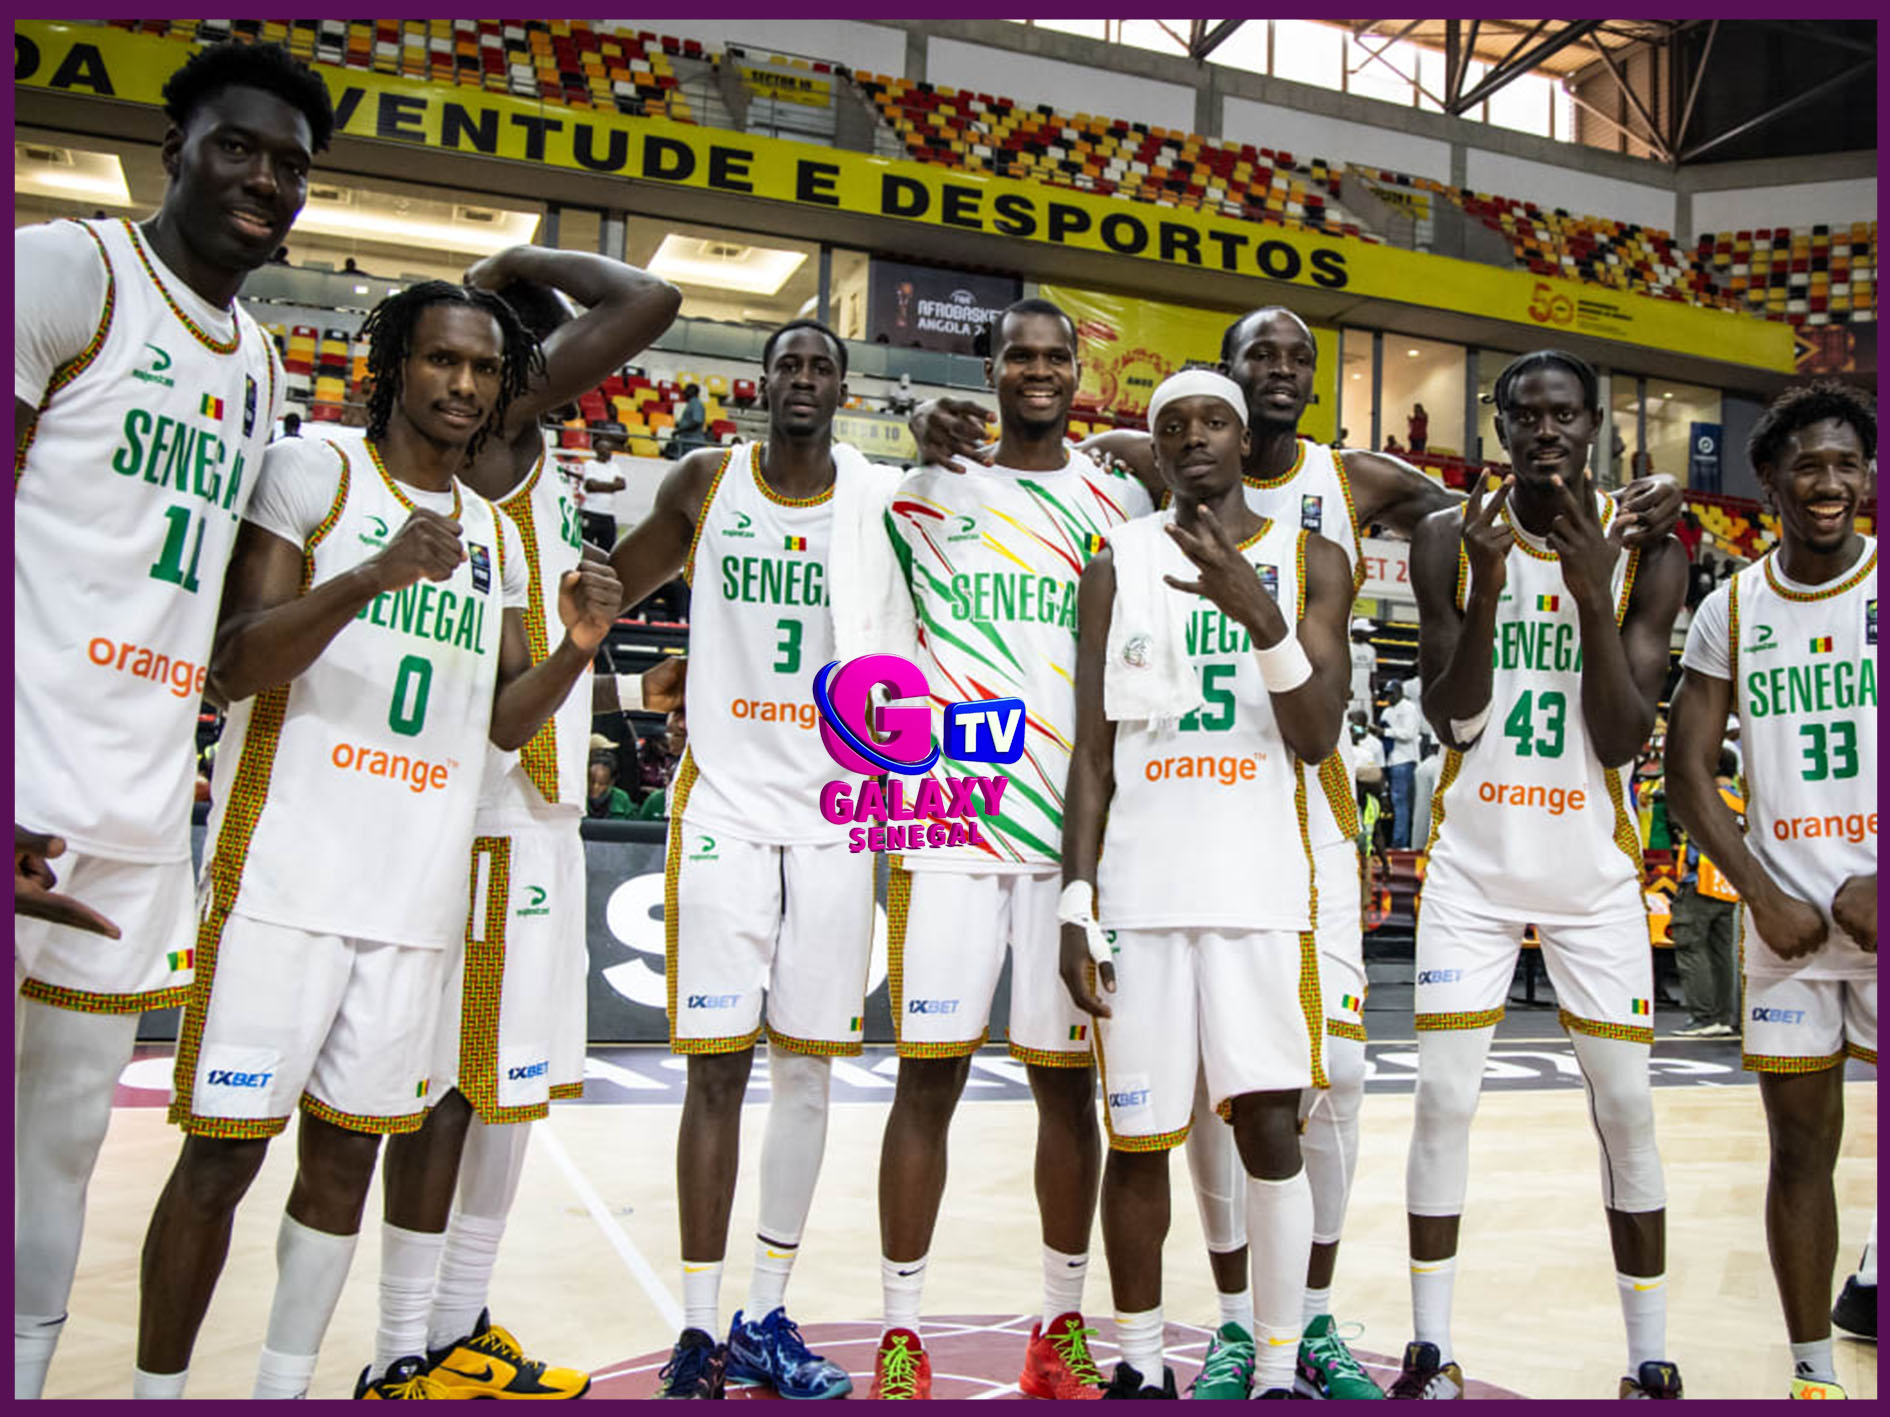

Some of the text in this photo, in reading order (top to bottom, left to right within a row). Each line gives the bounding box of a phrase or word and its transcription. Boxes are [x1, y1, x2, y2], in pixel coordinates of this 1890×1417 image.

[334, 86, 754, 194] VENTUDE
[796, 158, 840, 207] E
[881, 173, 1349, 289] DESPORTOS
[917, 317, 971, 336] ANGOLA
[112, 407, 244, 522] SENEGA
[722, 555, 830, 608] SENEG
[1366, 557, 1408, 582] ET 2
[356, 580, 486, 655] ENEGAL
[773, 618, 803, 675] 3
[388, 654, 433, 737] 0
[731, 698, 822, 730] orang
[1504, 689, 1567, 759] 43
[332, 742, 449, 794] orange
[1145, 755, 1258, 786] orange
[1799, 720, 1859, 782] 33
[1479, 781, 1586, 816] orange
[688, 995, 742, 1009] 1XBET
[909, 999, 960, 1014] 1XBET
[1752, 1007, 1806, 1025] 1XBET
[207, 1069, 273, 1088] 1XBET
